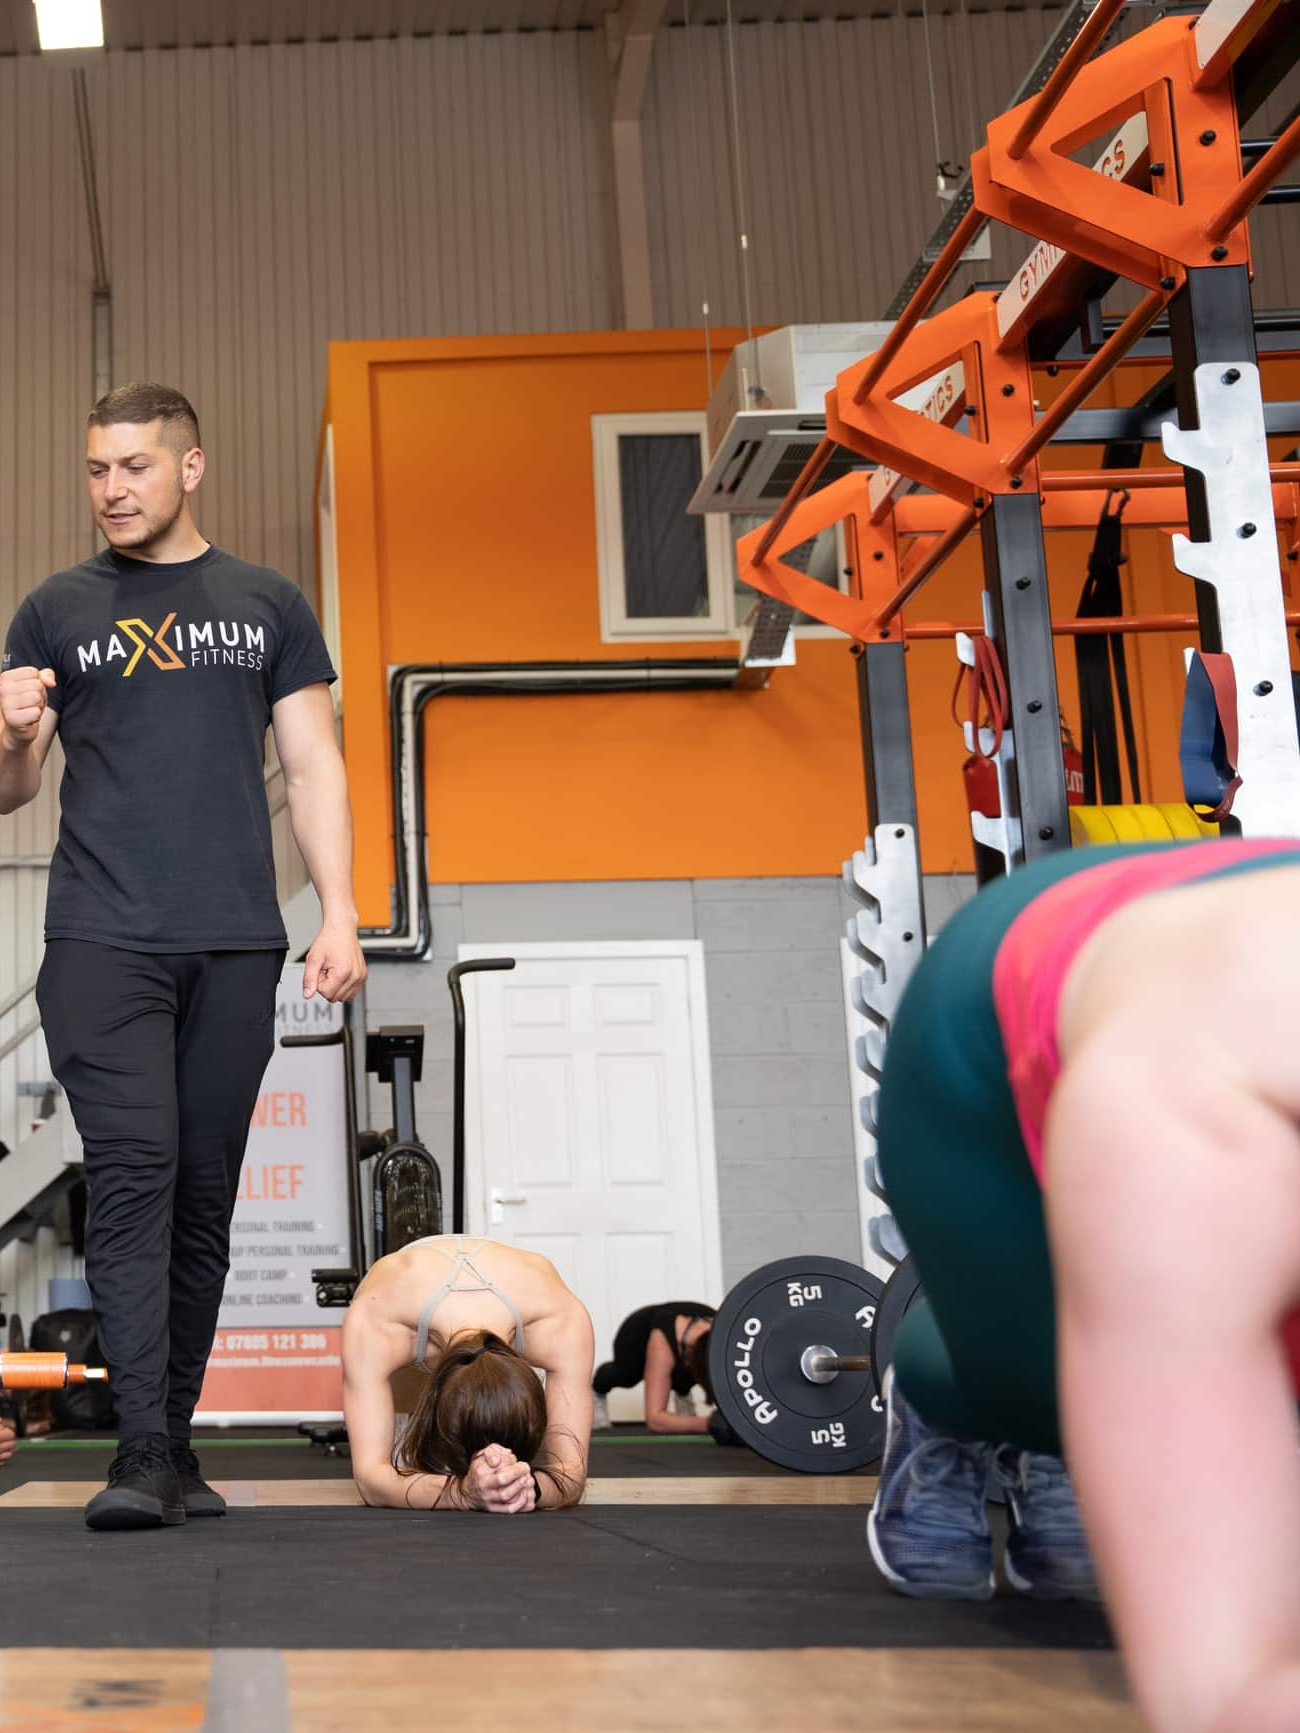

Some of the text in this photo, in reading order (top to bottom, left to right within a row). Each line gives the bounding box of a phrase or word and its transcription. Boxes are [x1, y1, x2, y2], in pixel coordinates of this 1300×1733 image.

[77, 612, 265, 677] MAXIMUM
[191, 649, 263, 671] FITNESS
[236, 1164, 304, 1200] LIEF
[734, 1317, 778, 1424] APOLLO
